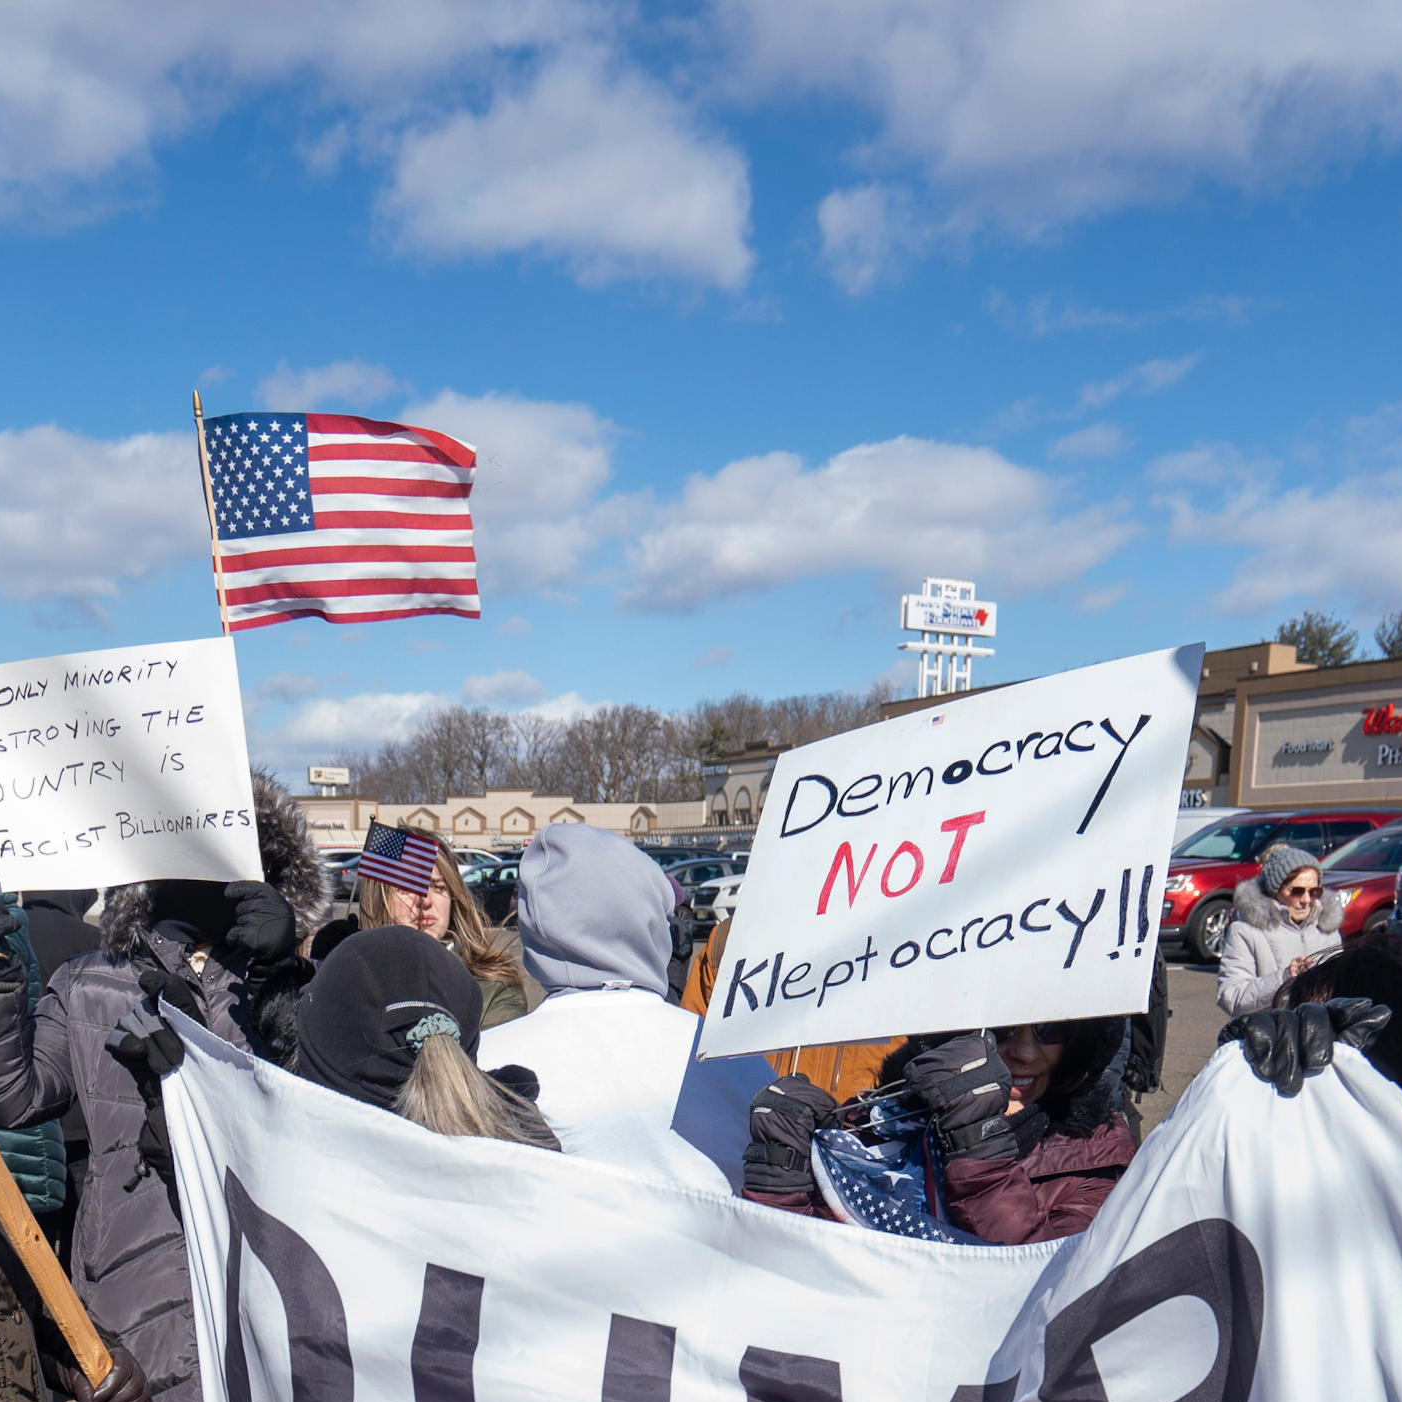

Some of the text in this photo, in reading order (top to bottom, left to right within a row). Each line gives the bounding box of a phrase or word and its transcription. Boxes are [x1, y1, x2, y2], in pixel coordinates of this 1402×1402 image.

[142, 704, 205, 734] THE
[779, 713, 1153, 840] Democracy
[815, 809, 987, 917] NOT
[721, 863, 1156, 1019] Kleptocracy!!
